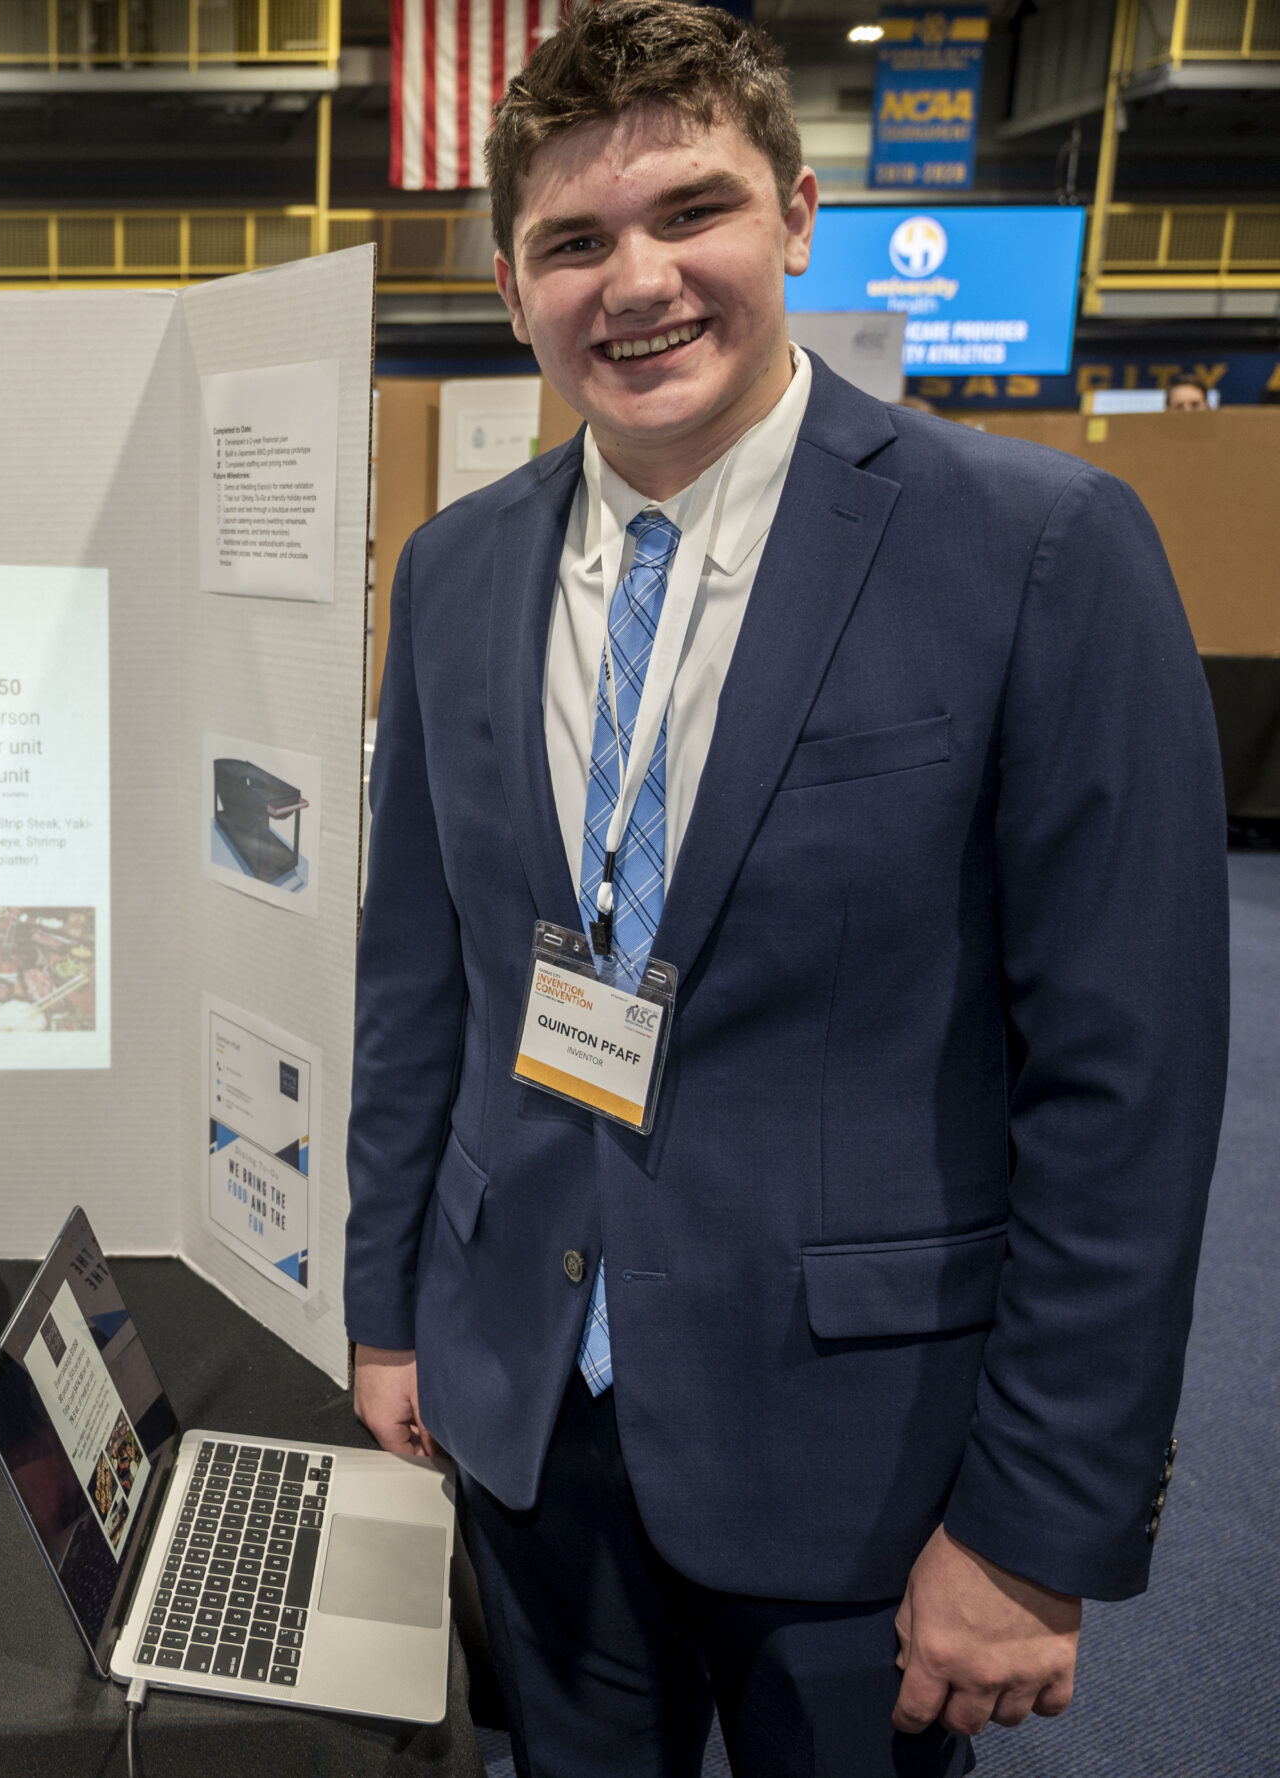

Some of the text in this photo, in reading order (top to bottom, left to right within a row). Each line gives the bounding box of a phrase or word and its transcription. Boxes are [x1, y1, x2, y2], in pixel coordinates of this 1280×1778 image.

[879, 90, 974, 122] NCAA
[867, 276, 959, 300] university
[952, 320, 1028, 342] PROVIDER
[927, 343, 1006, 364] ATHLETICS
[10, 738, 43, 755] unit
[26, 835, 67, 849] Shrimp
[626, 1004, 658, 1029] NSC
[537, 1014, 598, 1048] QUINTON
[600, 1039, 640, 1066] PFAFF
[567, 1046, 604, 1067] INVENTOR
[228, 1158, 286, 1210] WE BRING THE
[228, 1178, 286, 1231] FOOD AND THE
[248, 1213, 264, 1236] FUN
